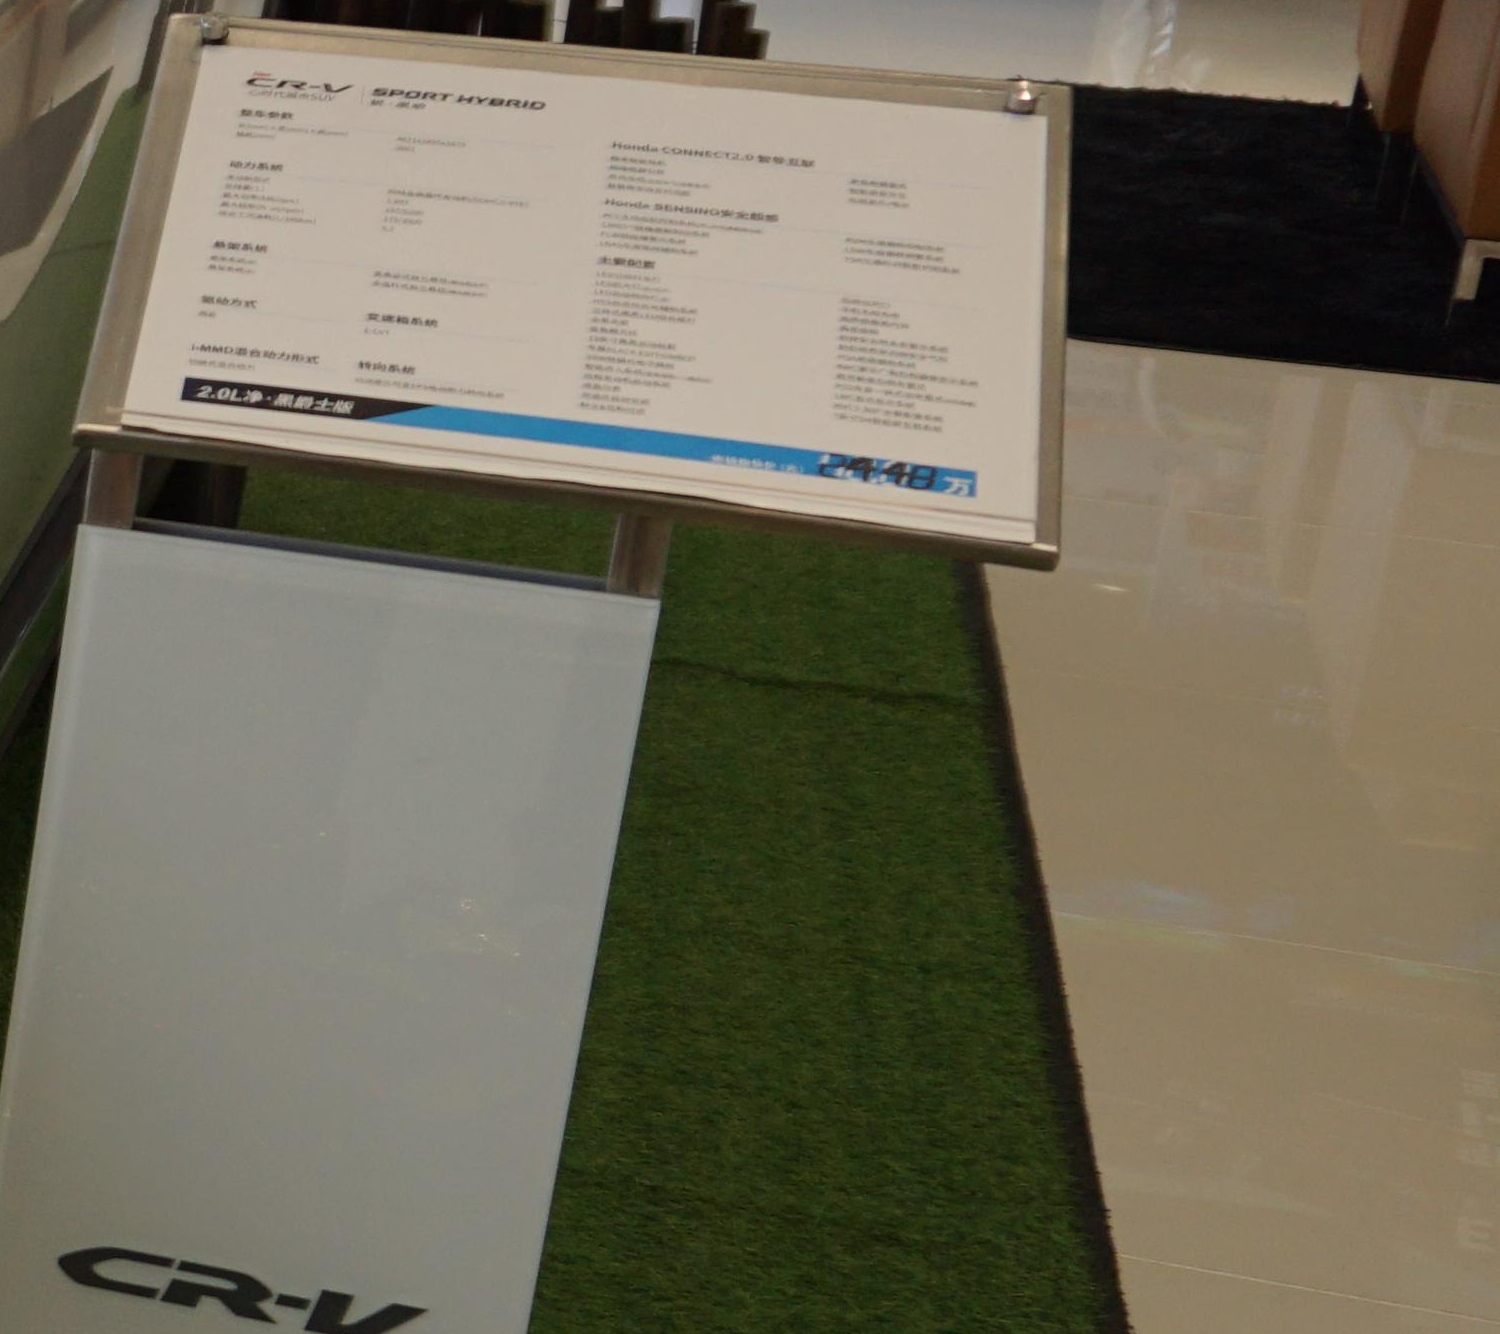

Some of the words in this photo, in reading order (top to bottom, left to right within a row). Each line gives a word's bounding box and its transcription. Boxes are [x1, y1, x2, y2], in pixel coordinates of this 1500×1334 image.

[246, 76, 354, 94] CR-V
[371, 87, 454, 102] SPORT
[456, 94, 547, 111] HYBRID
[611, 140, 659, 154] Honda
[604, 197, 651, 211] Honda
